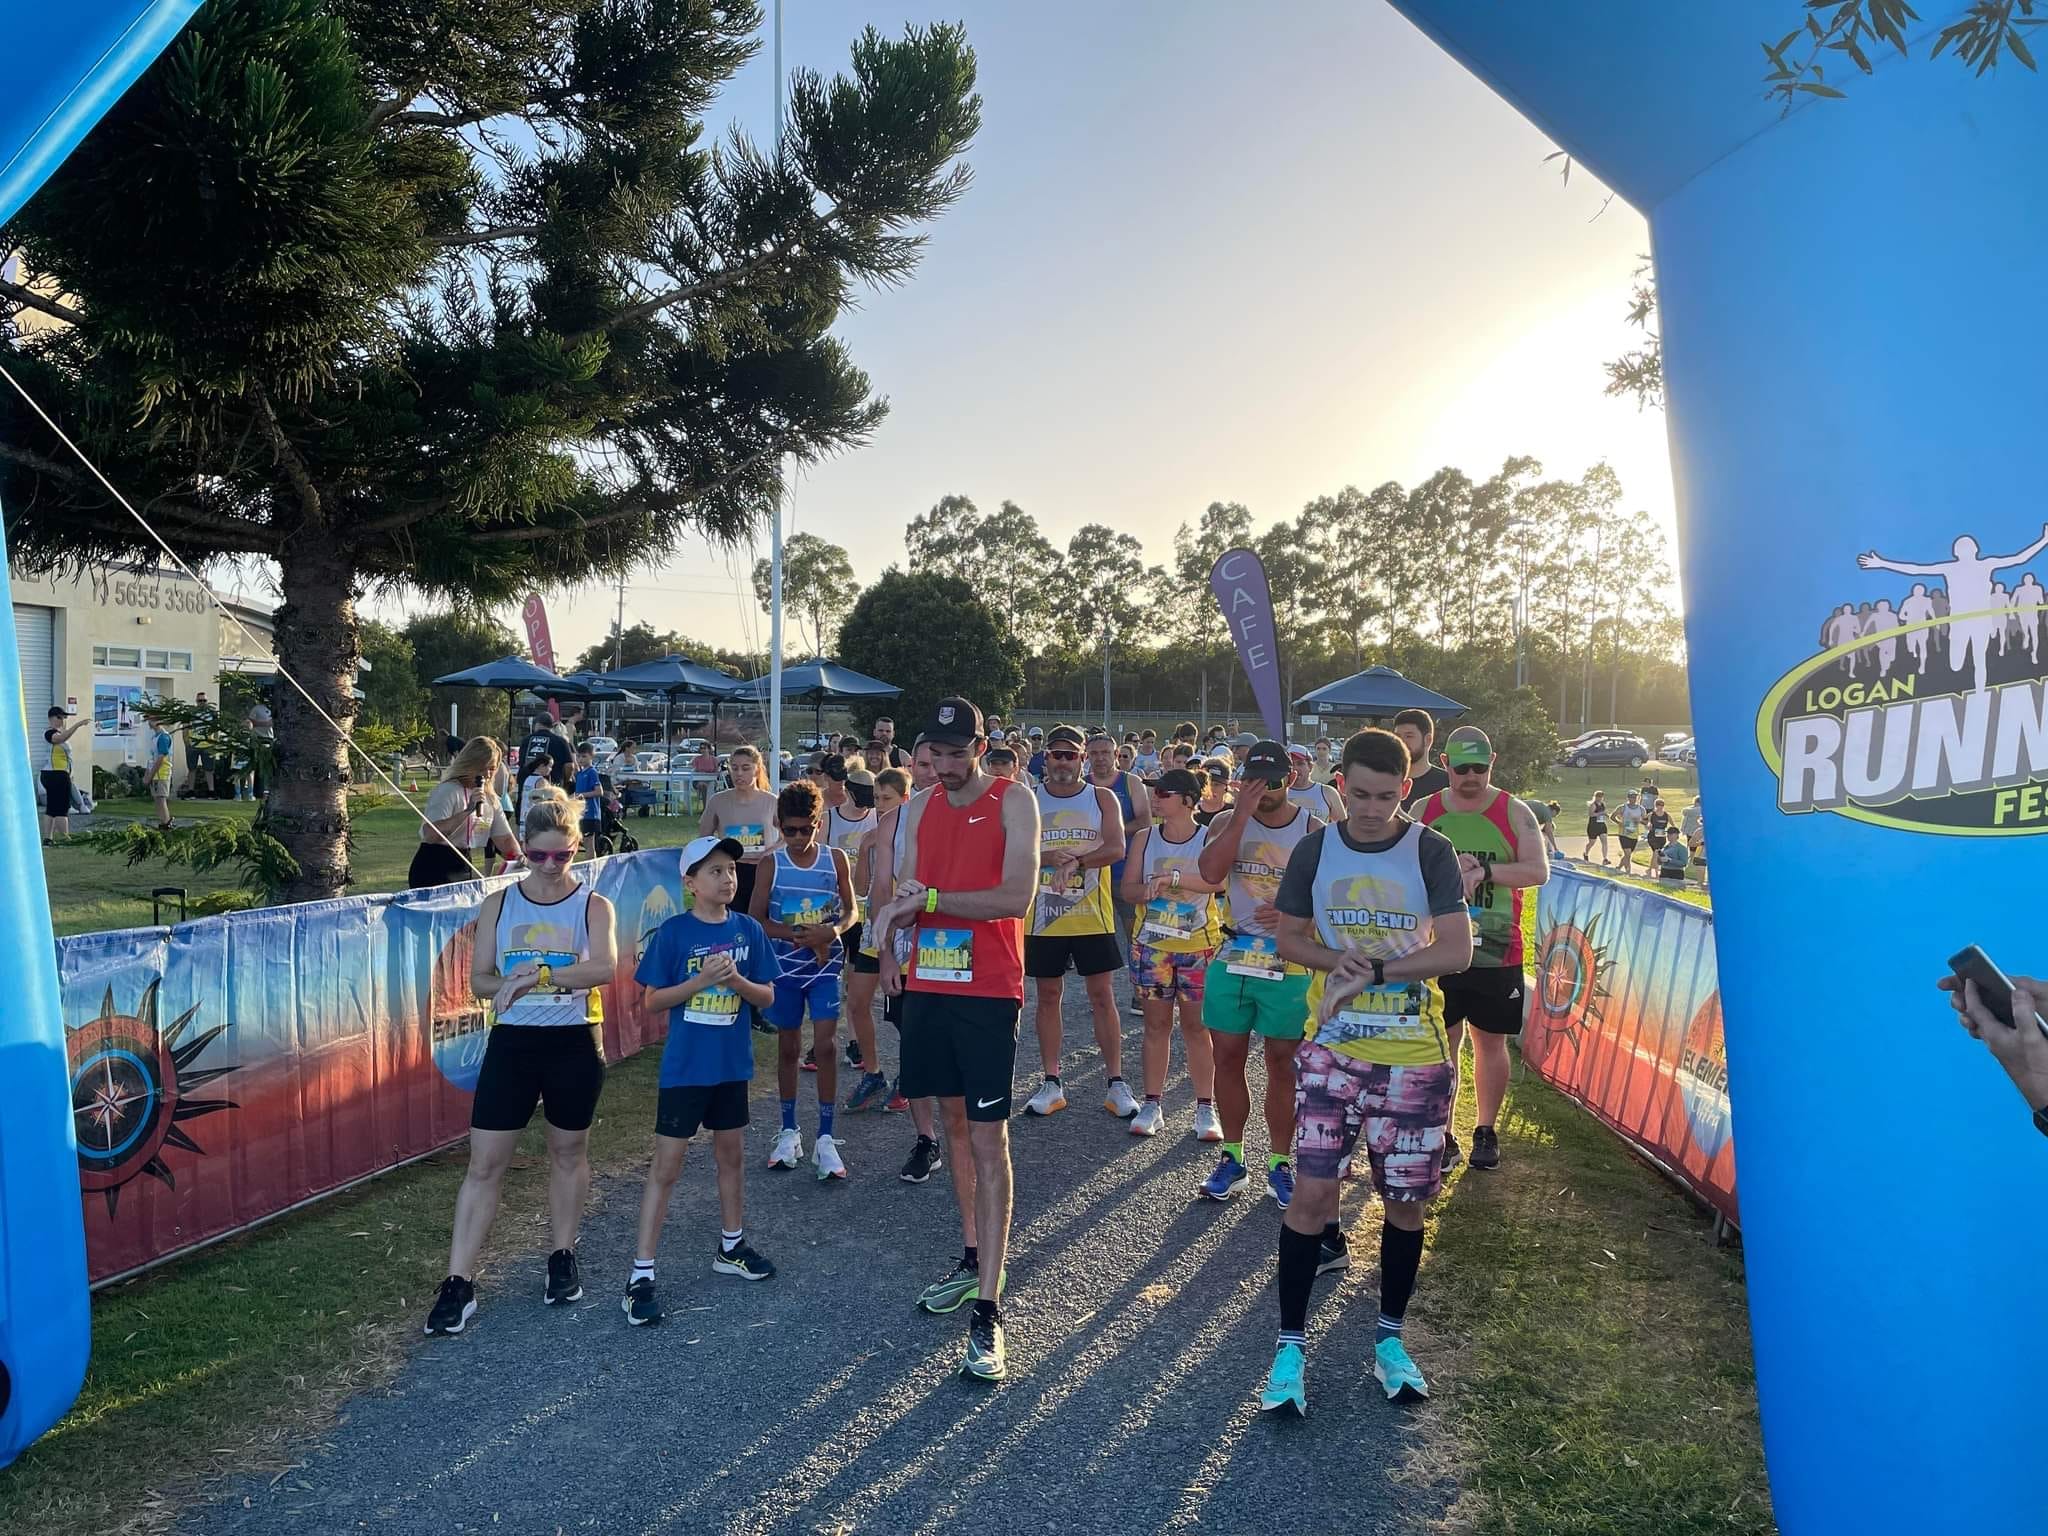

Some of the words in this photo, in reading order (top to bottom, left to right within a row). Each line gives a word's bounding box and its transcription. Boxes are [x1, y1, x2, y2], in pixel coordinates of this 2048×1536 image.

[115, 580, 161, 609] 5655
[164, 587, 206, 615] 3368
[1221, 555, 1269, 671] CAFE
[1805, 674, 1915, 713] LOGAN
[1780, 683, 2048, 804] RUNN
[1042, 829, 1097, 841] NDO-END
[794, 911, 823, 925] ASH
[1239, 949, 1273, 970] JEFF
[690, 991, 740, 1013] ETHAN
[1352, 992, 1409, 1013] MATT
[434, 1012, 485, 1041] ELEM
